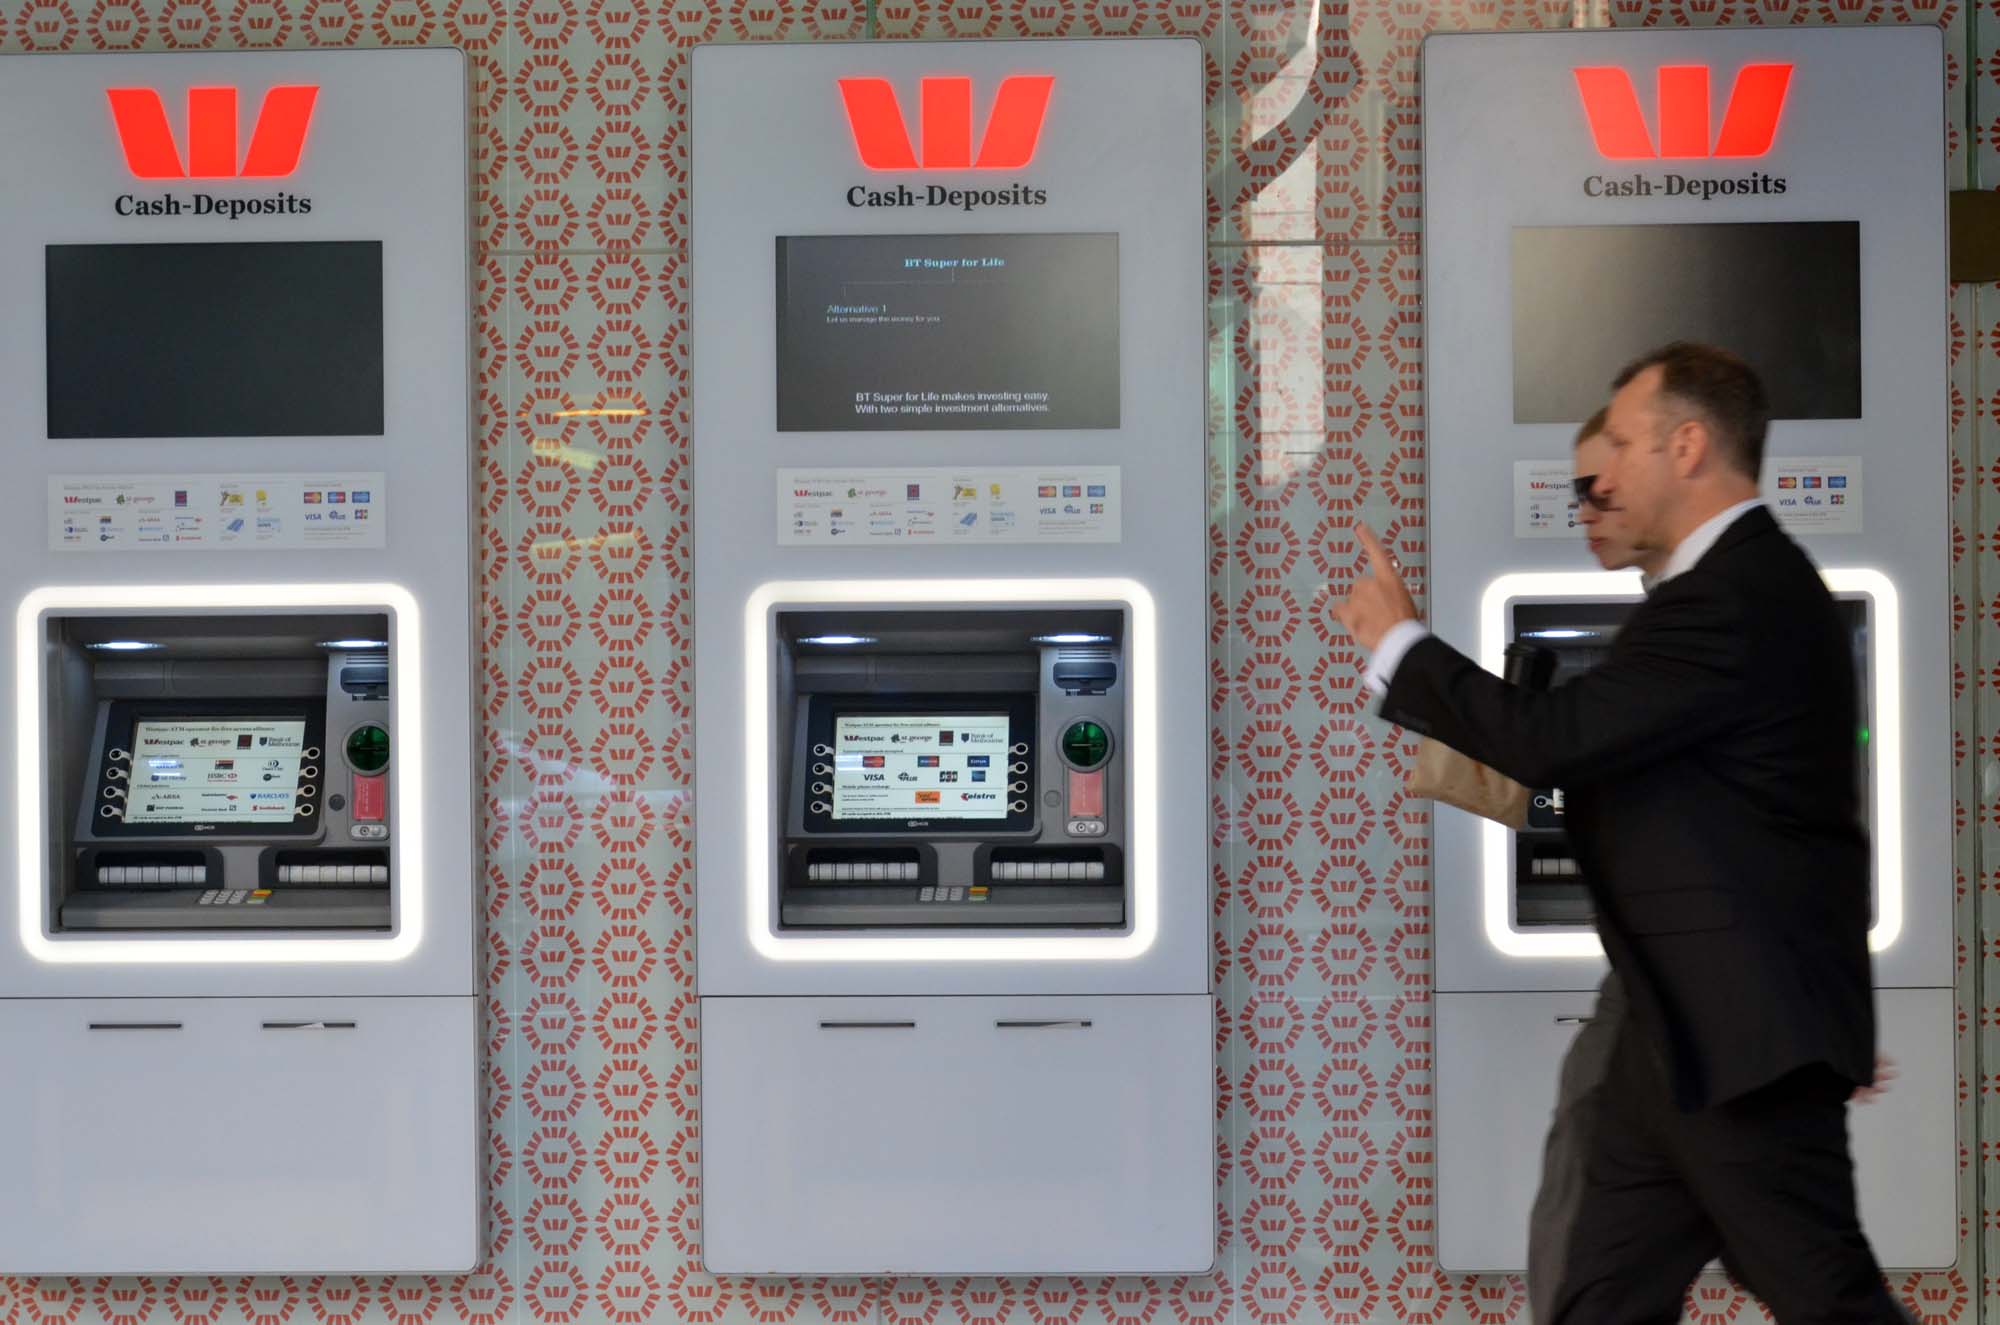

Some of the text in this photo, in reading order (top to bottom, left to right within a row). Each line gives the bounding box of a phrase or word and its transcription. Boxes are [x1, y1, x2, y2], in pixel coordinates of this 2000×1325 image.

[1583, 172, 1786, 200] Cash-Deposits
[846, 183, 1047, 211] Cash-Deposits
[115, 192, 312, 220] Cash-Deposits
[904, 257, 1005, 269] BT Super for Life
[826, 304, 879, 314] Alternative
[855, 391, 871, 402] BT
[872, 391, 903, 404] Super
[905, 391, 919, 402] for
[921, 391, 940, 402] Life
[941, 391, 976, 402] makes
[977, 391, 1022, 404] investing
[854, 404, 878, 414] With
[880, 404, 899, 414] two
[900, 403, 933, 416] simple
[935, 403, 989, 414] investment
[1778, 498, 1797, 506] VISA
[304, 513, 323, 521] VISA
[844, 735, 885, 743] Westpac
